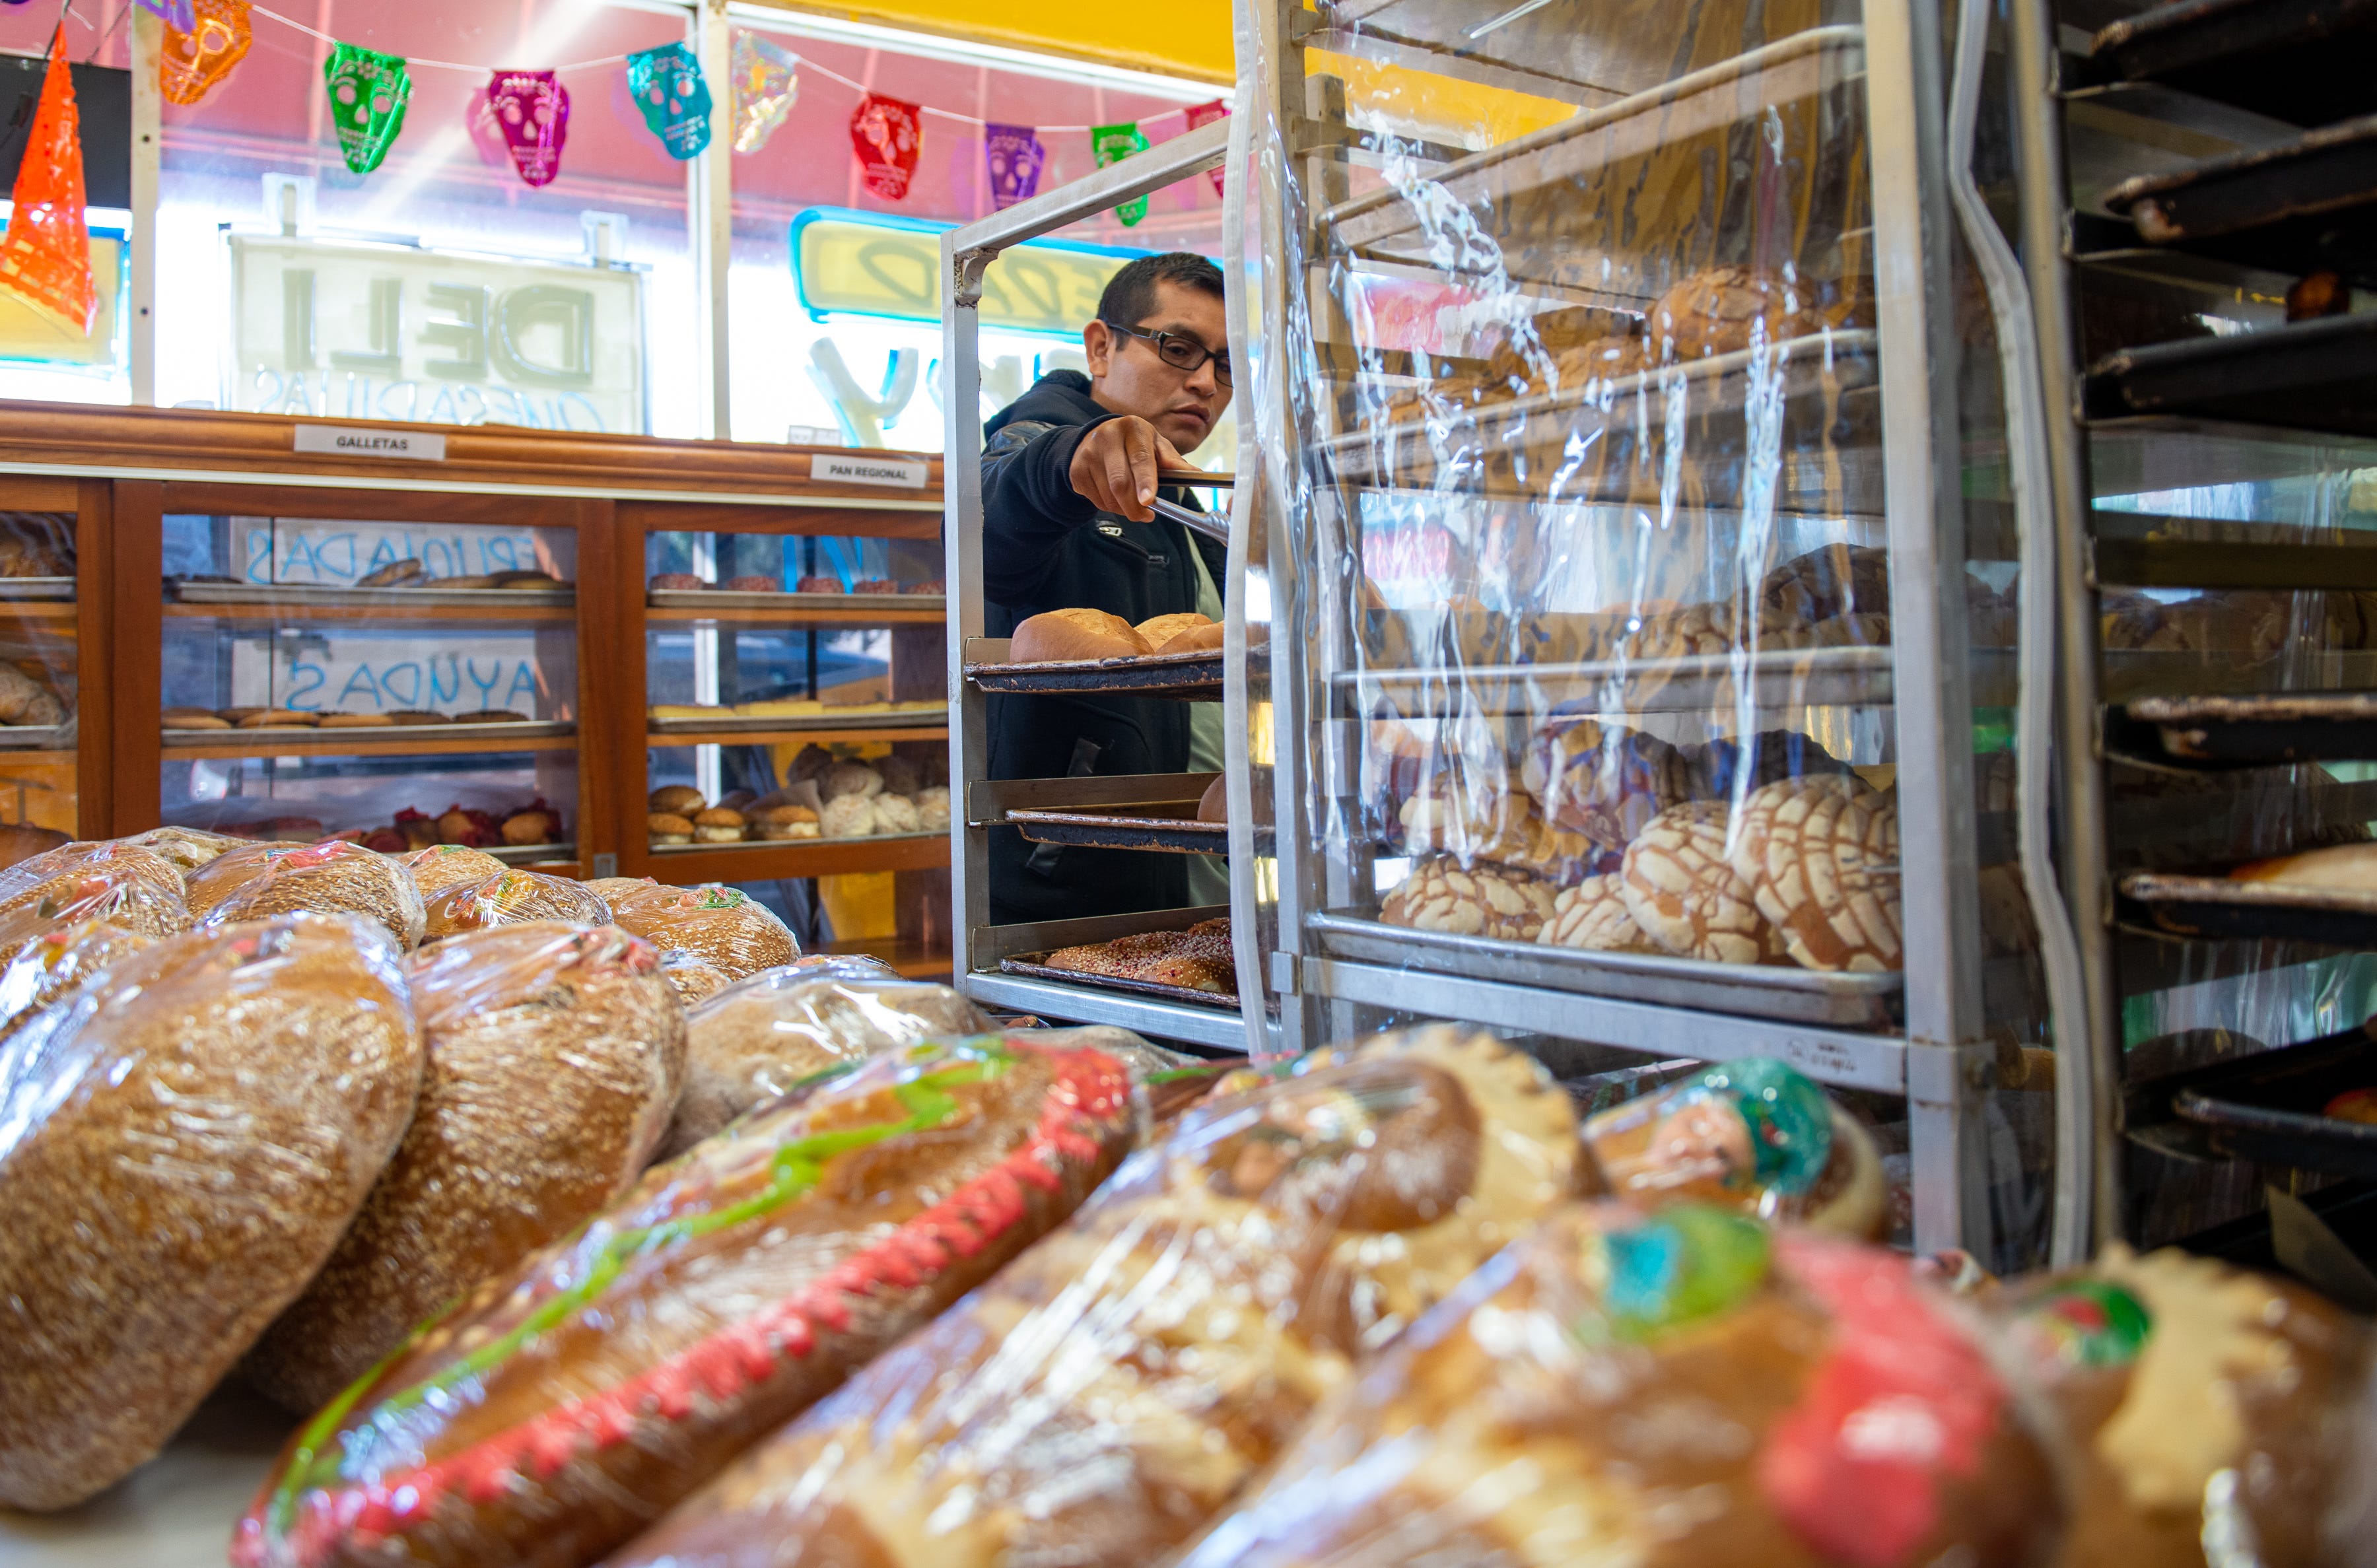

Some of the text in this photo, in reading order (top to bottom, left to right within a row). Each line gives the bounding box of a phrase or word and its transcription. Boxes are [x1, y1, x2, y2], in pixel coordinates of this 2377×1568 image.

[337, 436, 409, 450] GALLETAS
[830, 465, 907, 479] PAN REGIONAL
